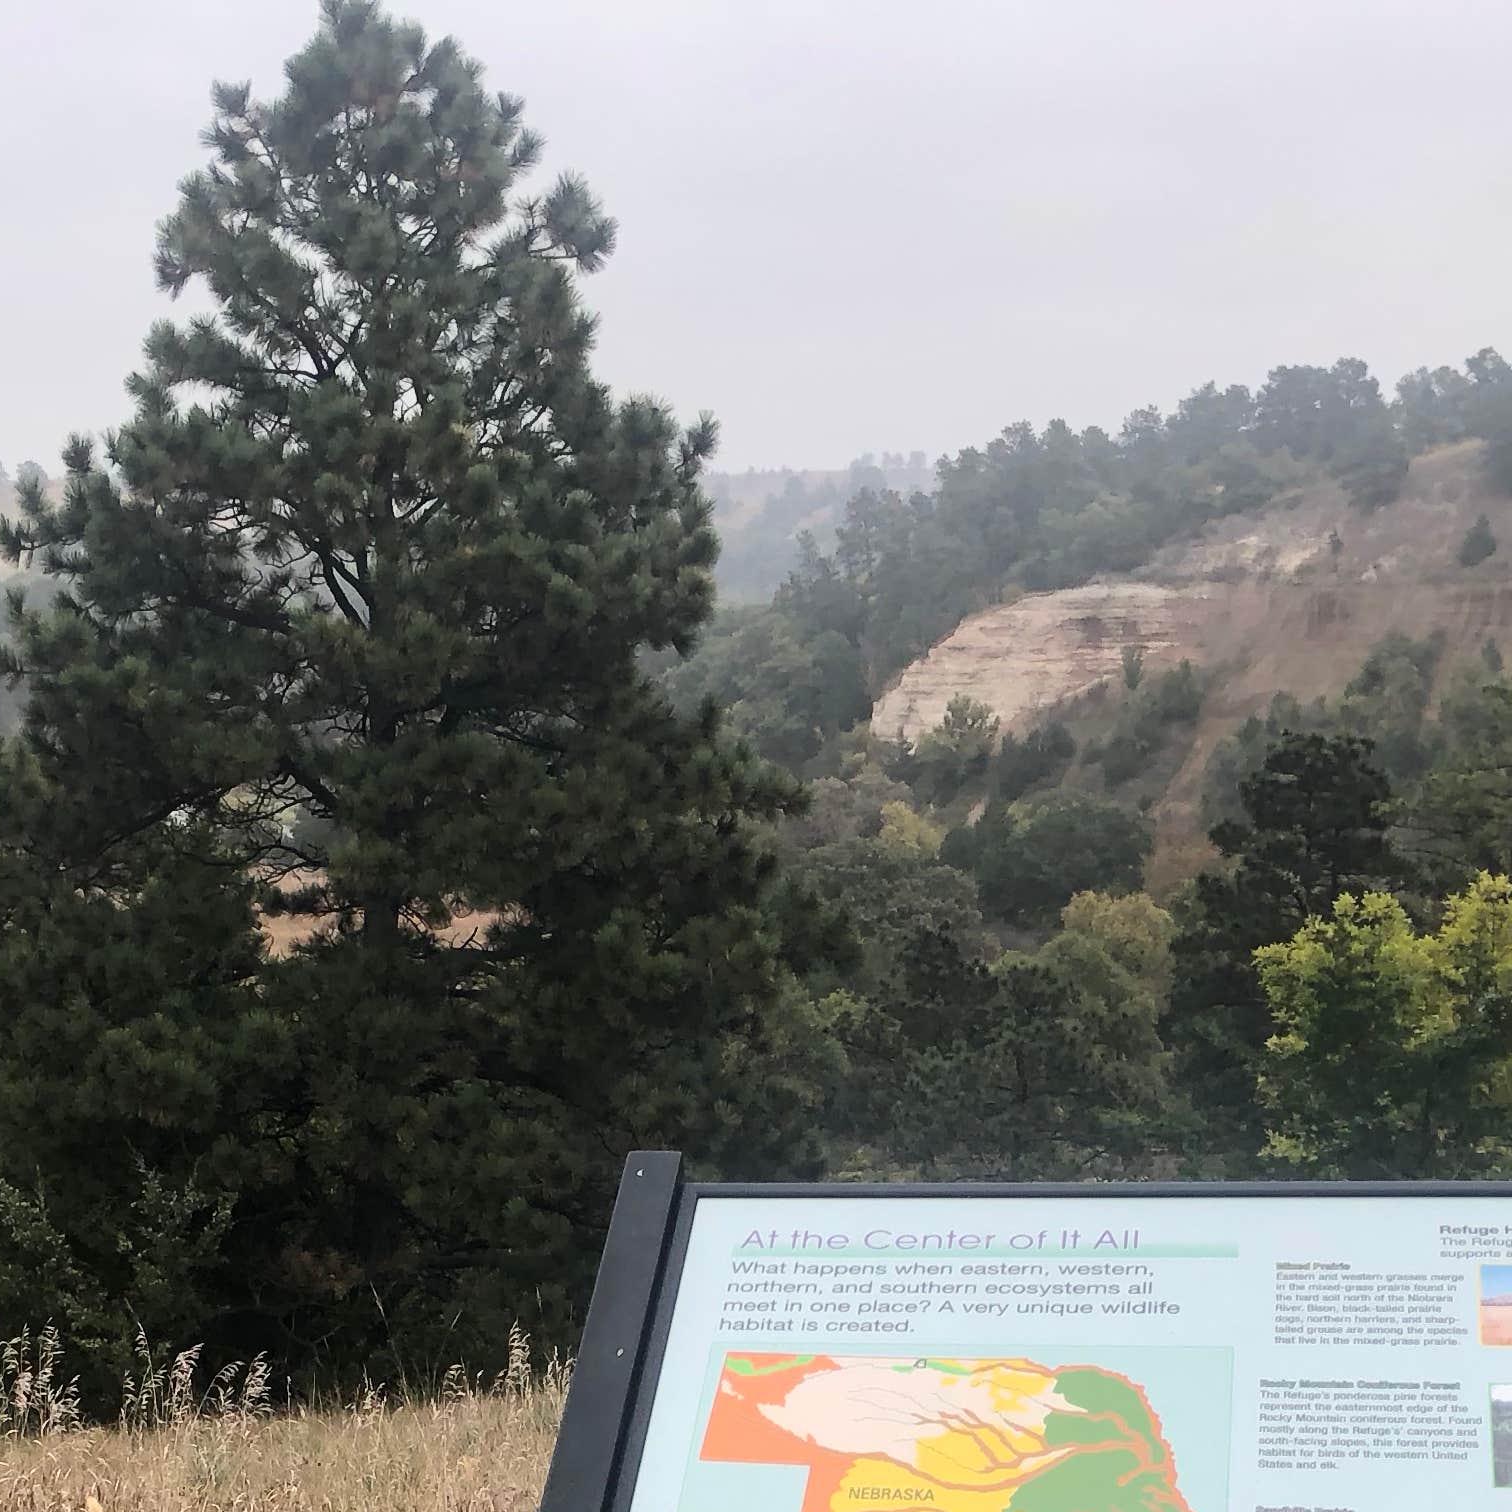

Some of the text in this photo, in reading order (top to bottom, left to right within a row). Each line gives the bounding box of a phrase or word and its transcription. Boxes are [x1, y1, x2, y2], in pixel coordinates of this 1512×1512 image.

[1439, 1225, 1499, 1237] Refuge
[740, 1230, 1139, 1250] At the Center of It All
[1440, 1236, 1467, 1246] The
[1440, 1248, 1501, 1260] supports
[732, 1261, 1154, 1278] What happens when eastern, western,
[727, 1280, 1153, 1298] northern, and southern ecosystems all
[723, 1299, 1180, 1317] meet in one place? A very unique wildlife
[719, 1318, 914, 1332] habitat is created.
[1260, 1390, 1458, 1402] The Refuge's ponderosa pine forests
[1259, 1403, 1469, 1414] represent the easternmost edge of the
[1259, 1413, 1292, 1423] Rocky
[1295, 1413, 1347, 1423] Mountain
[1349, 1415, 1407, 1424] coniferous
[1448, 1416, 1482, 1425] Found
[1257, 1460, 1293, 1469] States
[1296, 1461, 1317, 1469] and
[848, 1487, 935, 1501] NEBRASKA
